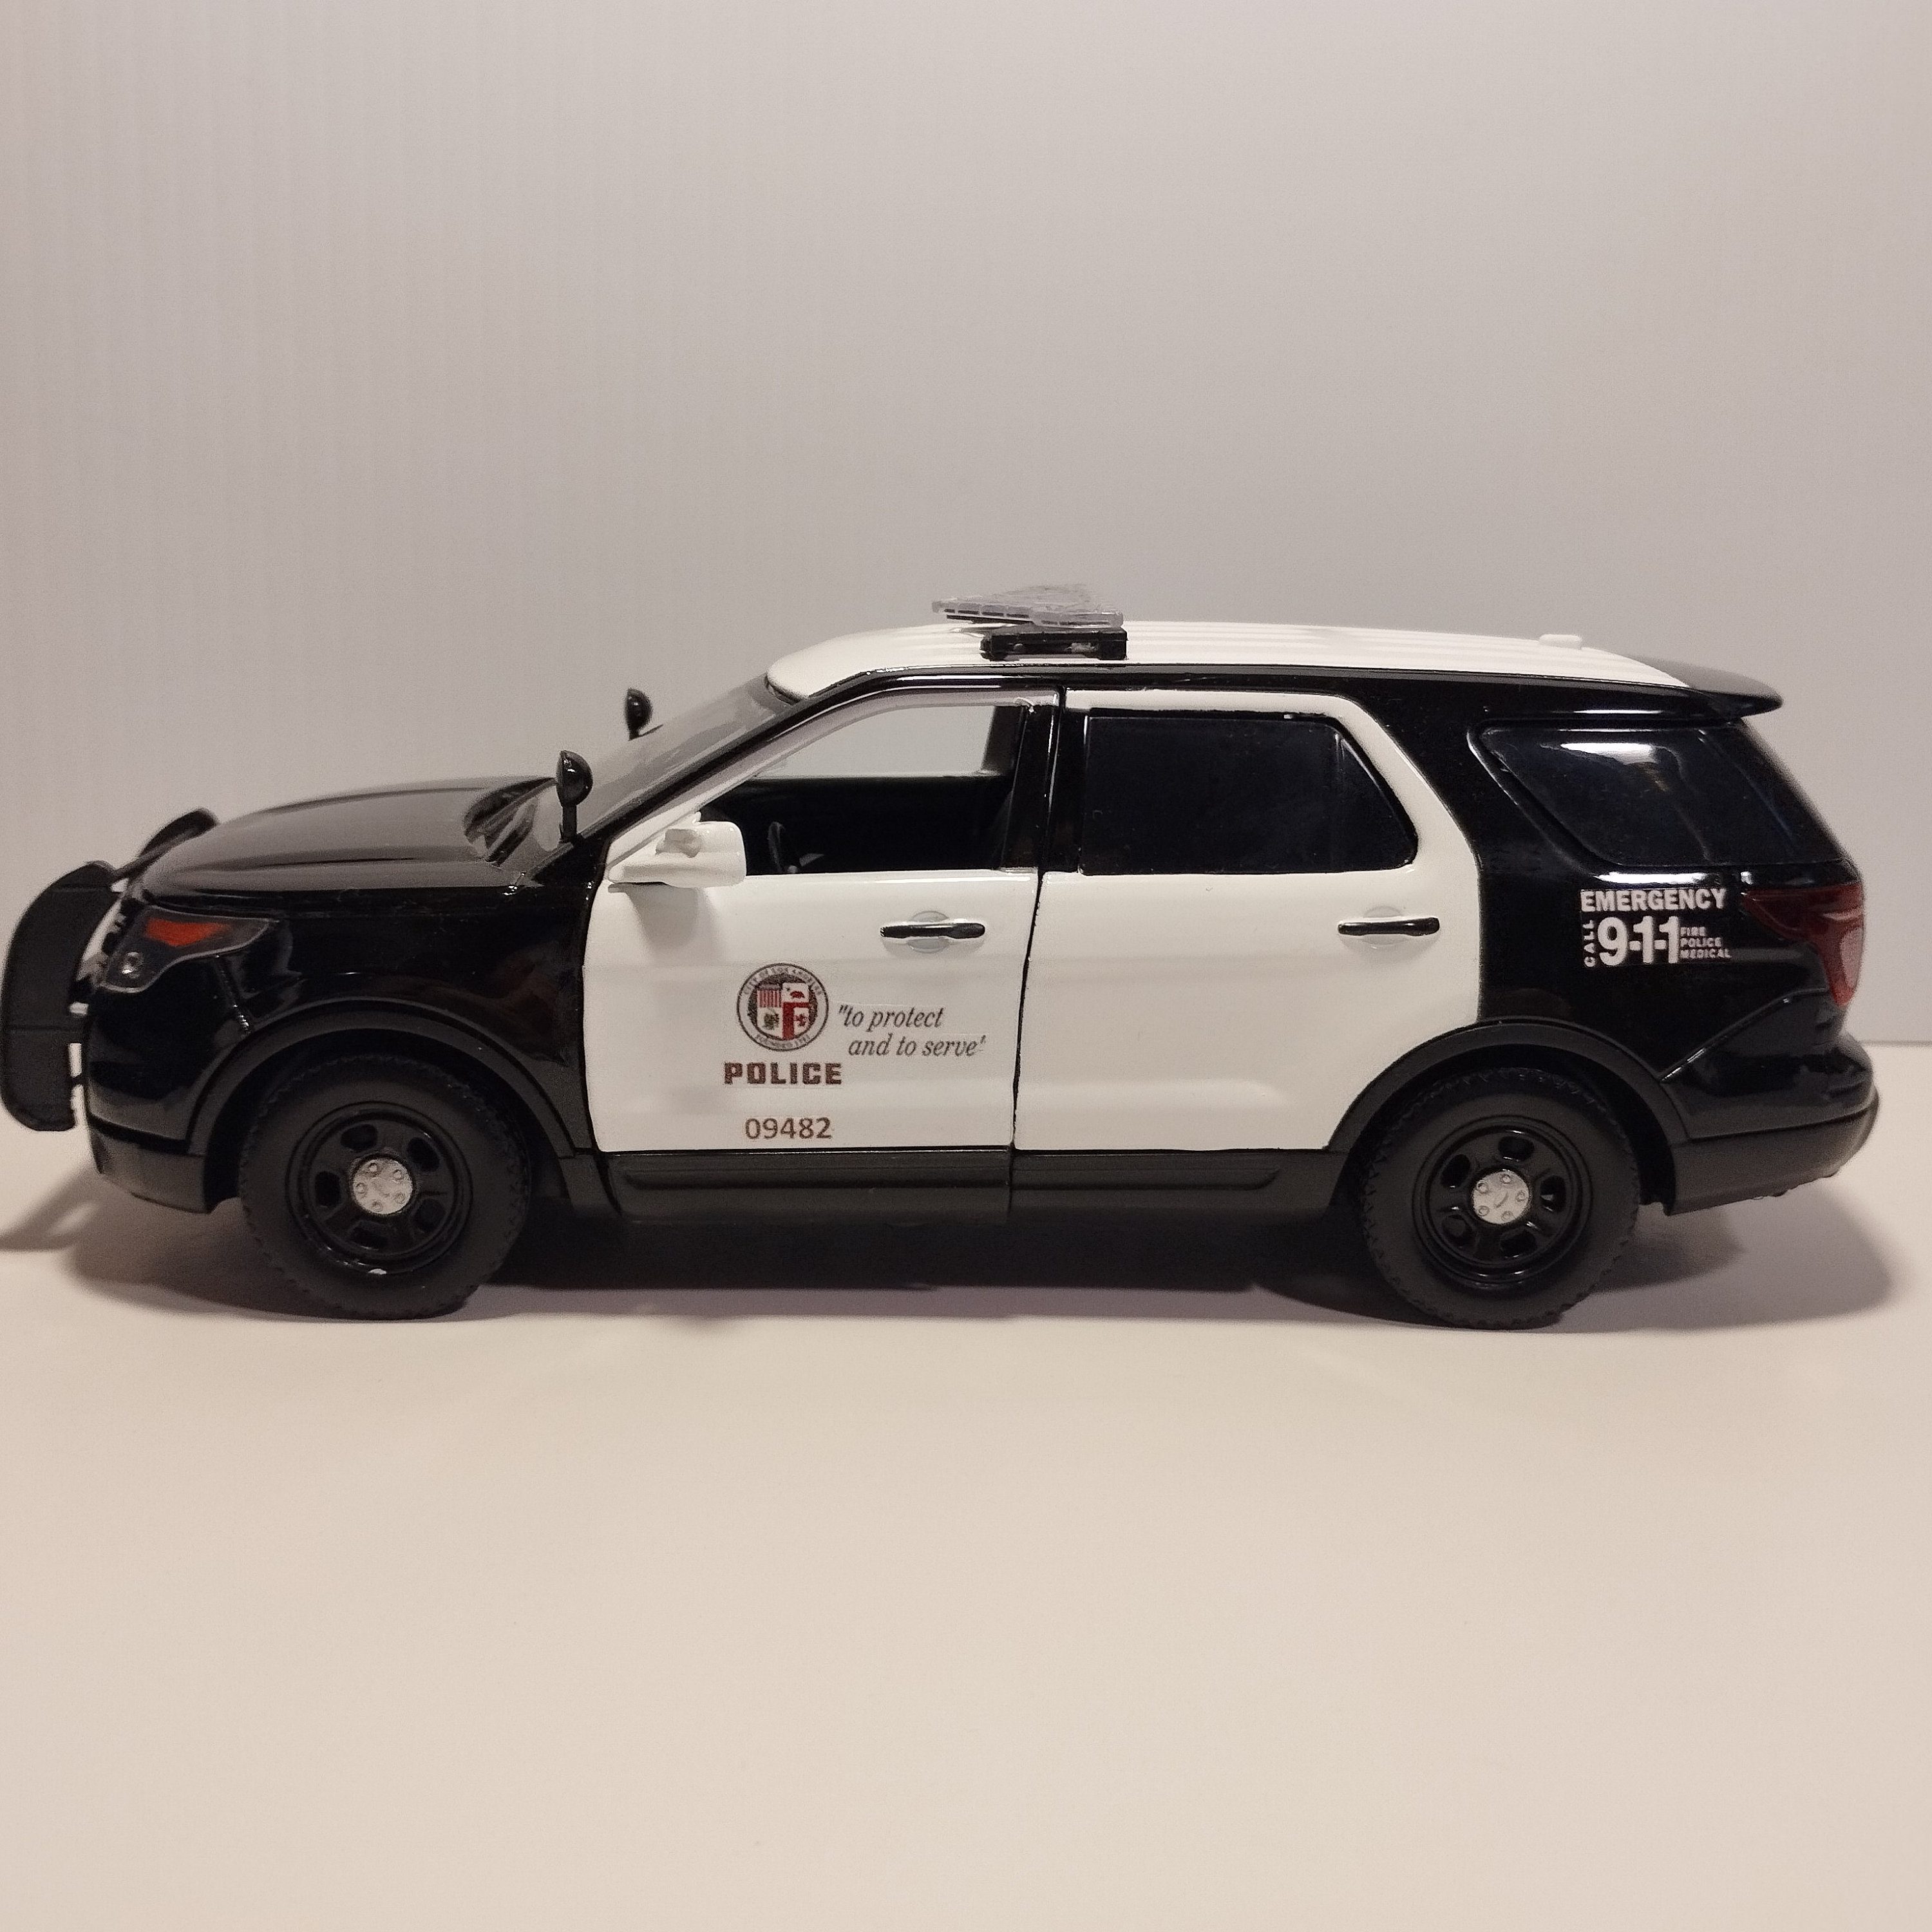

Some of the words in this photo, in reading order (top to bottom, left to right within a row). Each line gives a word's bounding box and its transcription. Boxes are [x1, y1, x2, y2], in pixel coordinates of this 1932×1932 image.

[1580, 889, 1727, 912] EMERGENCY
[1598, 916, 1679, 966] 9-1-1
[1680, 927, 1705, 936] FIRE
[1680, 937, 1721, 947] POLICE
[1583, 920, 1596, 967] CALL
[1680, 949, 1731, 958] MEDICAL
[866, 1007, 945, 1032] protect
[848, 1032, 893, 1056] and
[896, 1036, 917, 1056] to
[724, 1063, 842, 1085] POLICE
[745, 1117, 833, 1139] 09482
